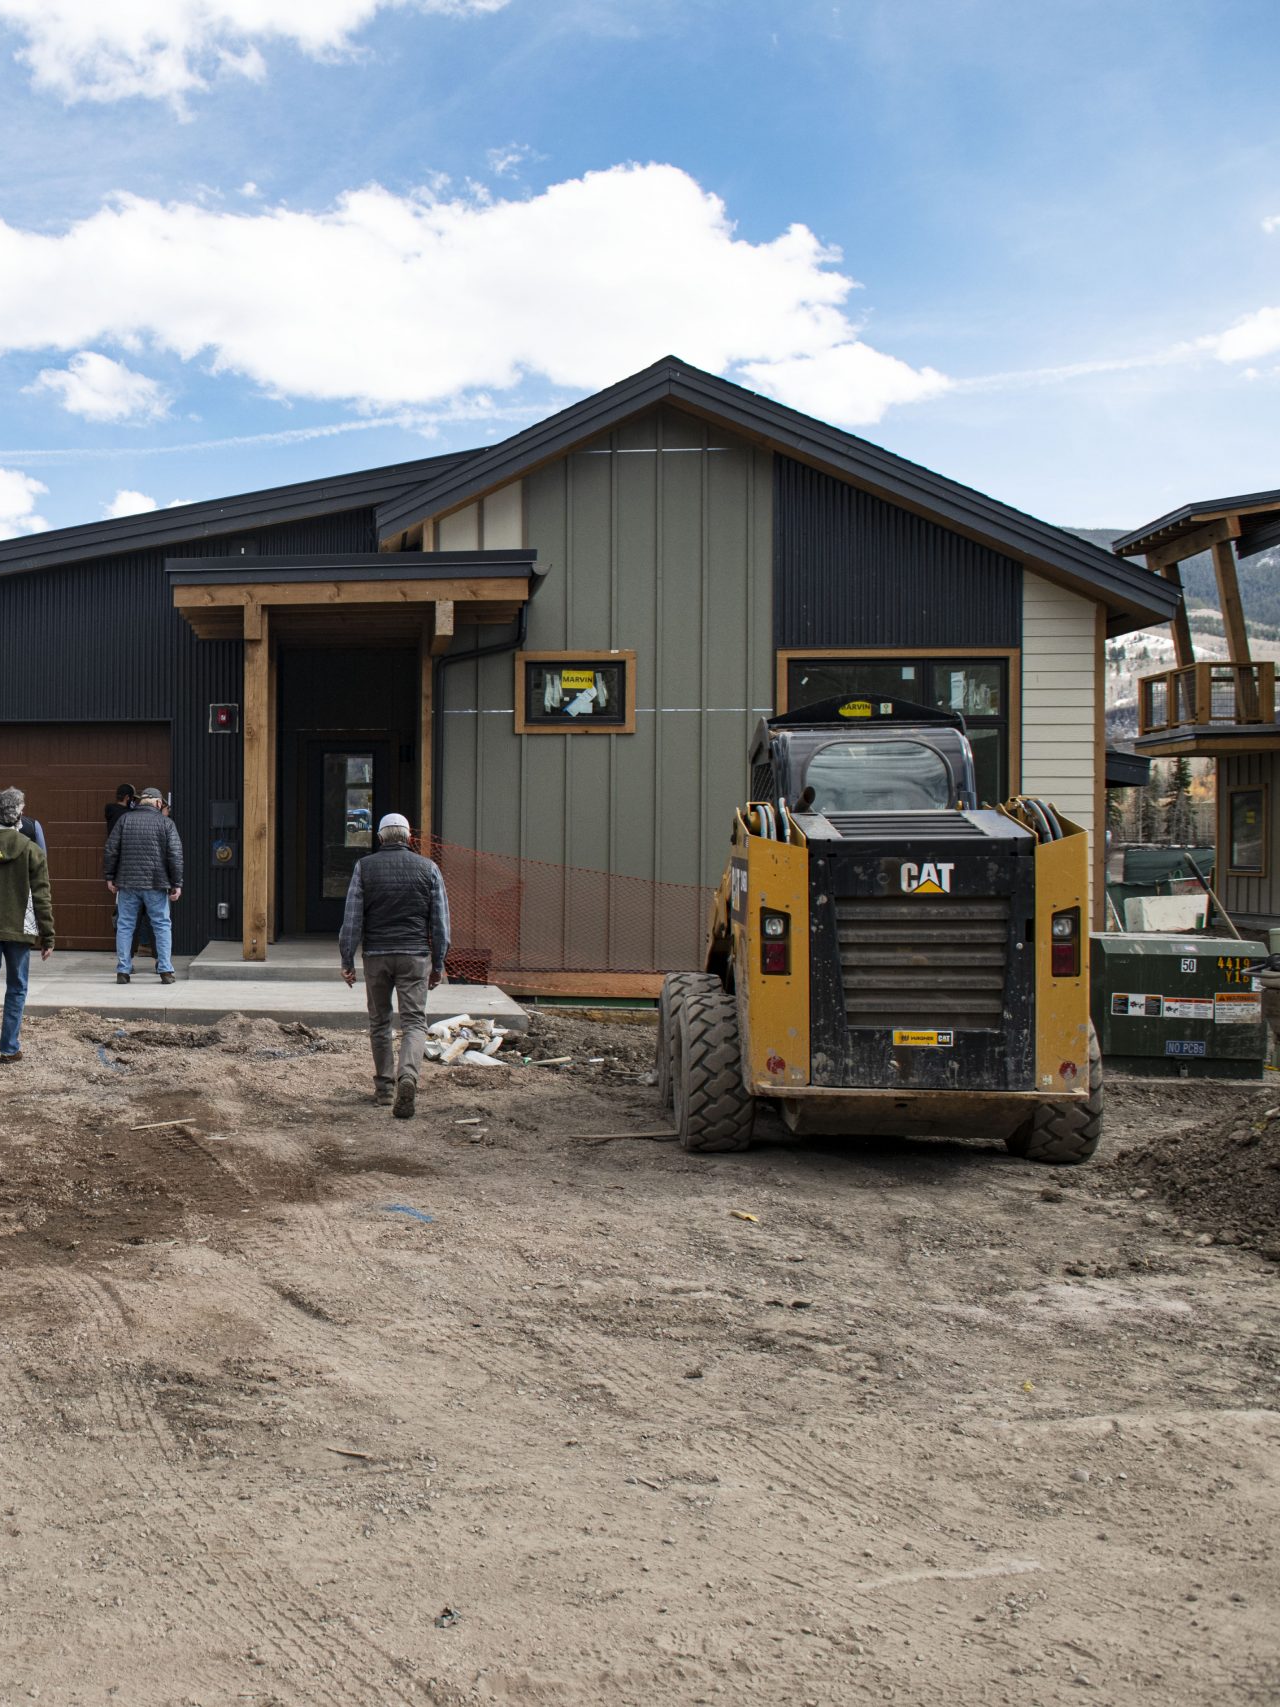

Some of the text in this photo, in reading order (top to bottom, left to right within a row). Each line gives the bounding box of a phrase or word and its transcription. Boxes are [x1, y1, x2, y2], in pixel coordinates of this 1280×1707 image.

[901, 862, 955, 893] CAT
[1182, 959, 1195, 971] 50
[1217, 956, 1250, 969] 4419
[938, 1034, 951, 1043] CAT
[1168, 1043, 1204, 1054] NO PCBs
